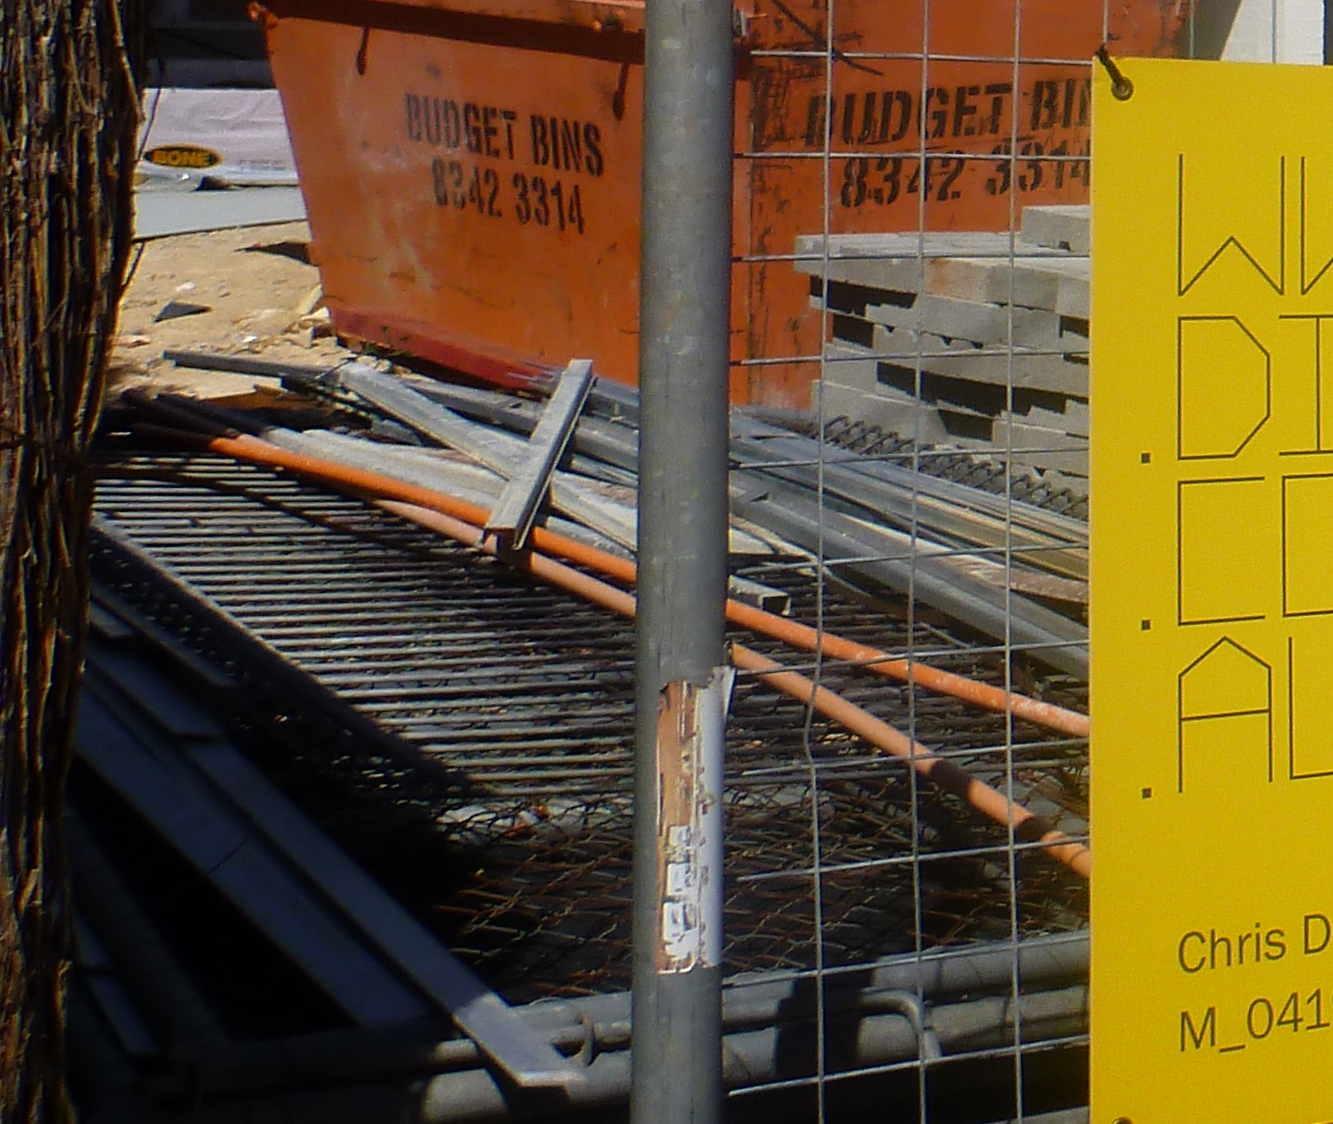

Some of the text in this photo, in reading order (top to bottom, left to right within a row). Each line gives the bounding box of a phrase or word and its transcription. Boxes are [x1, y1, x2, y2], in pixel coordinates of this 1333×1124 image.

[405, 93, 604, 177] BUDGET BINS
[804, 82, 1014, 147] BUDGET
[431, 158, 585, 235] 8342 3314
[841, 150, 966, 208] 8342
[1177, 922, 1287, 974] Chris
